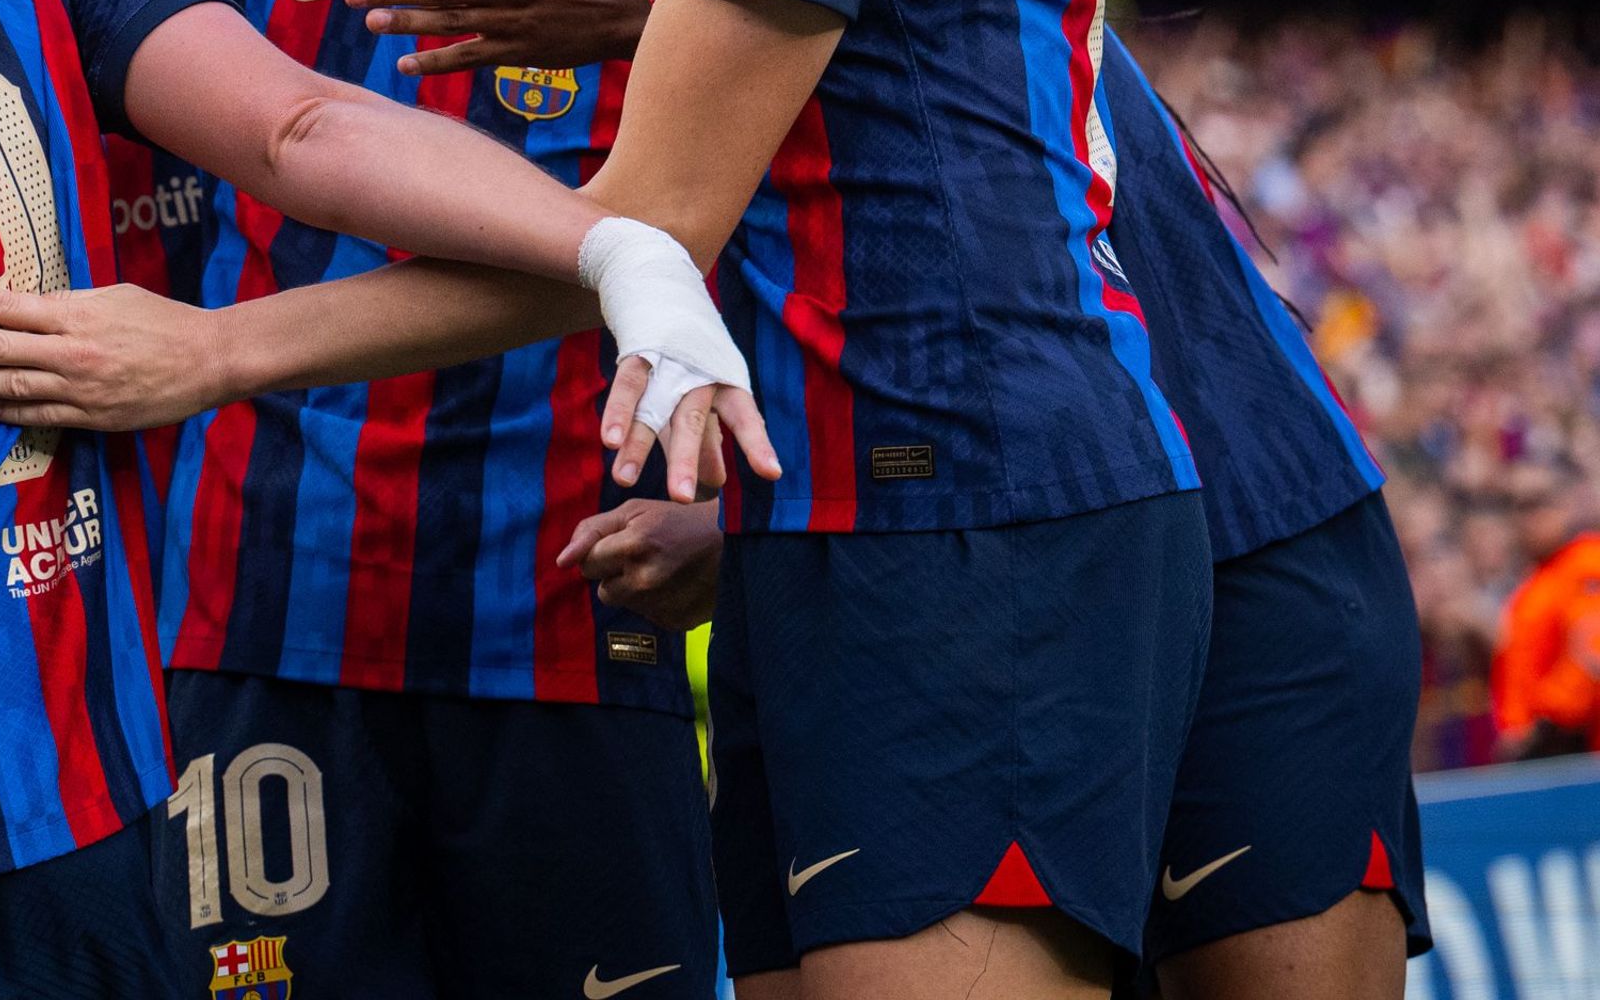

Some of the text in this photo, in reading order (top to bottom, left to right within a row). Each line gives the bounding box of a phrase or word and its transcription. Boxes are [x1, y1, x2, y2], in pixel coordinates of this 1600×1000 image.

[521, 71, 553, 85] FCB
[9, 587, 31, 599] The
[32, 582, 50, 595] UN
[167, 743, 330, 929] 10
[234, 971, 266, 986] FCB
